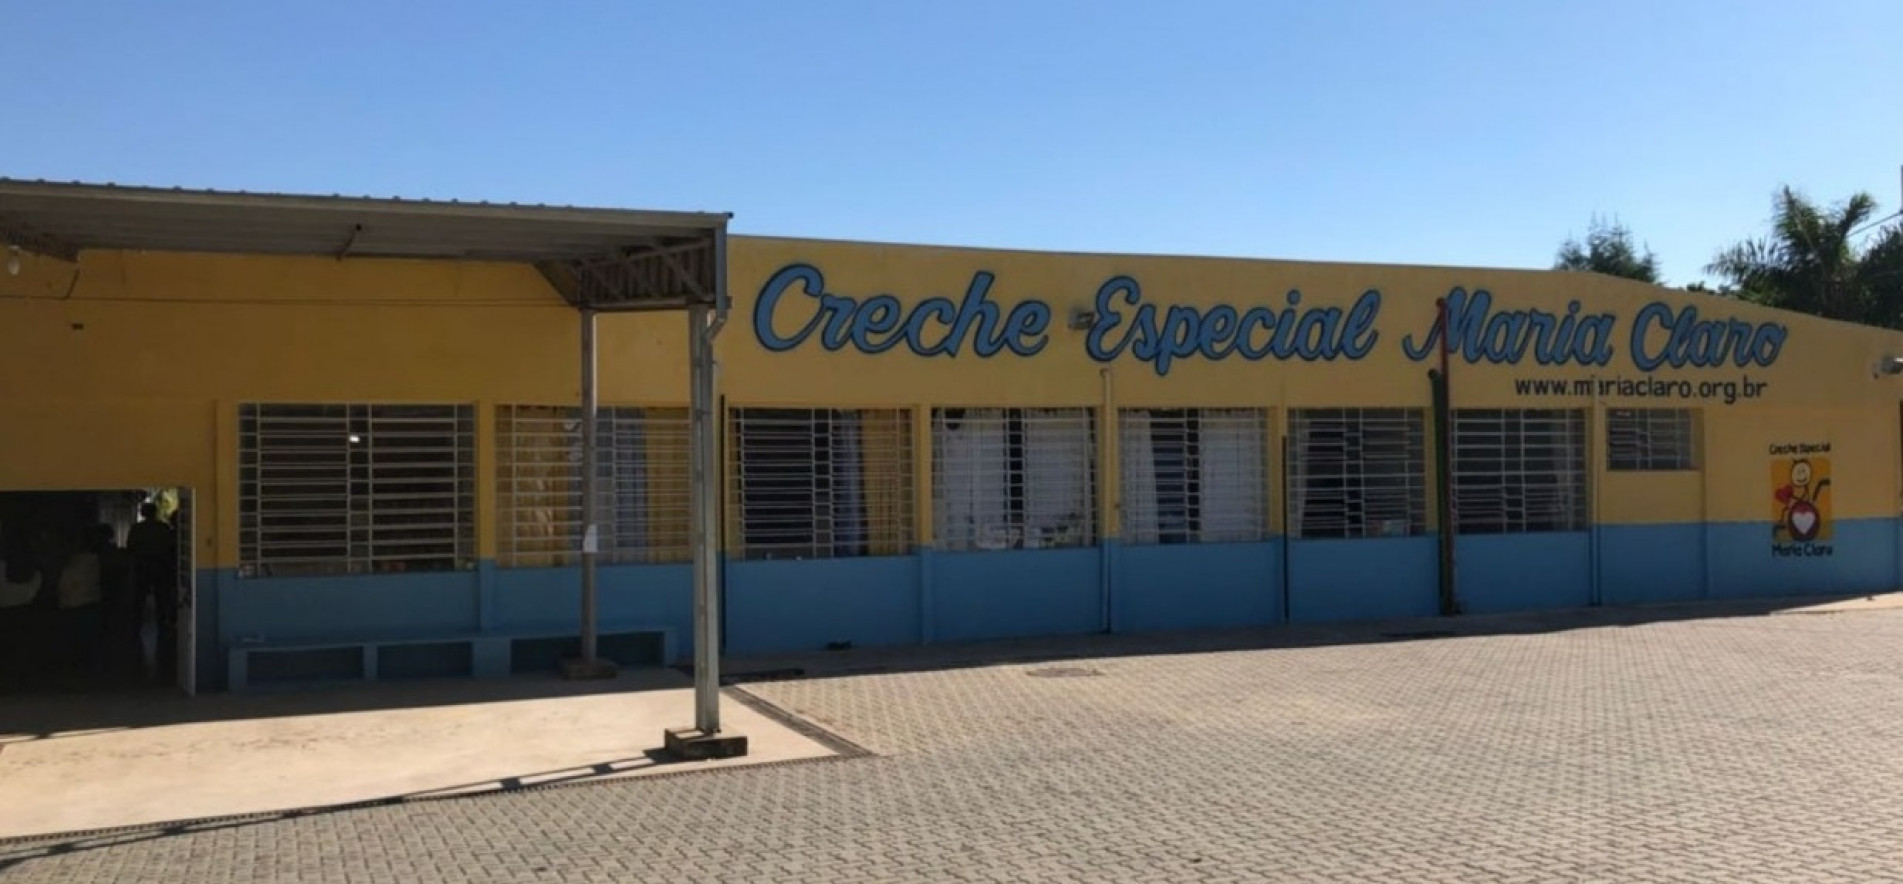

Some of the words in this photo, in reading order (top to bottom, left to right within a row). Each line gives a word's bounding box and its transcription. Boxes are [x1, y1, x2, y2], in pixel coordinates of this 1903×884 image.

[753, 263, 1051, 358] Creche
[1086, 275, 1381, 376] Especial
[1402, 286, 1616, 364] Maria
[1630, 302, 1788, 371] Claro
